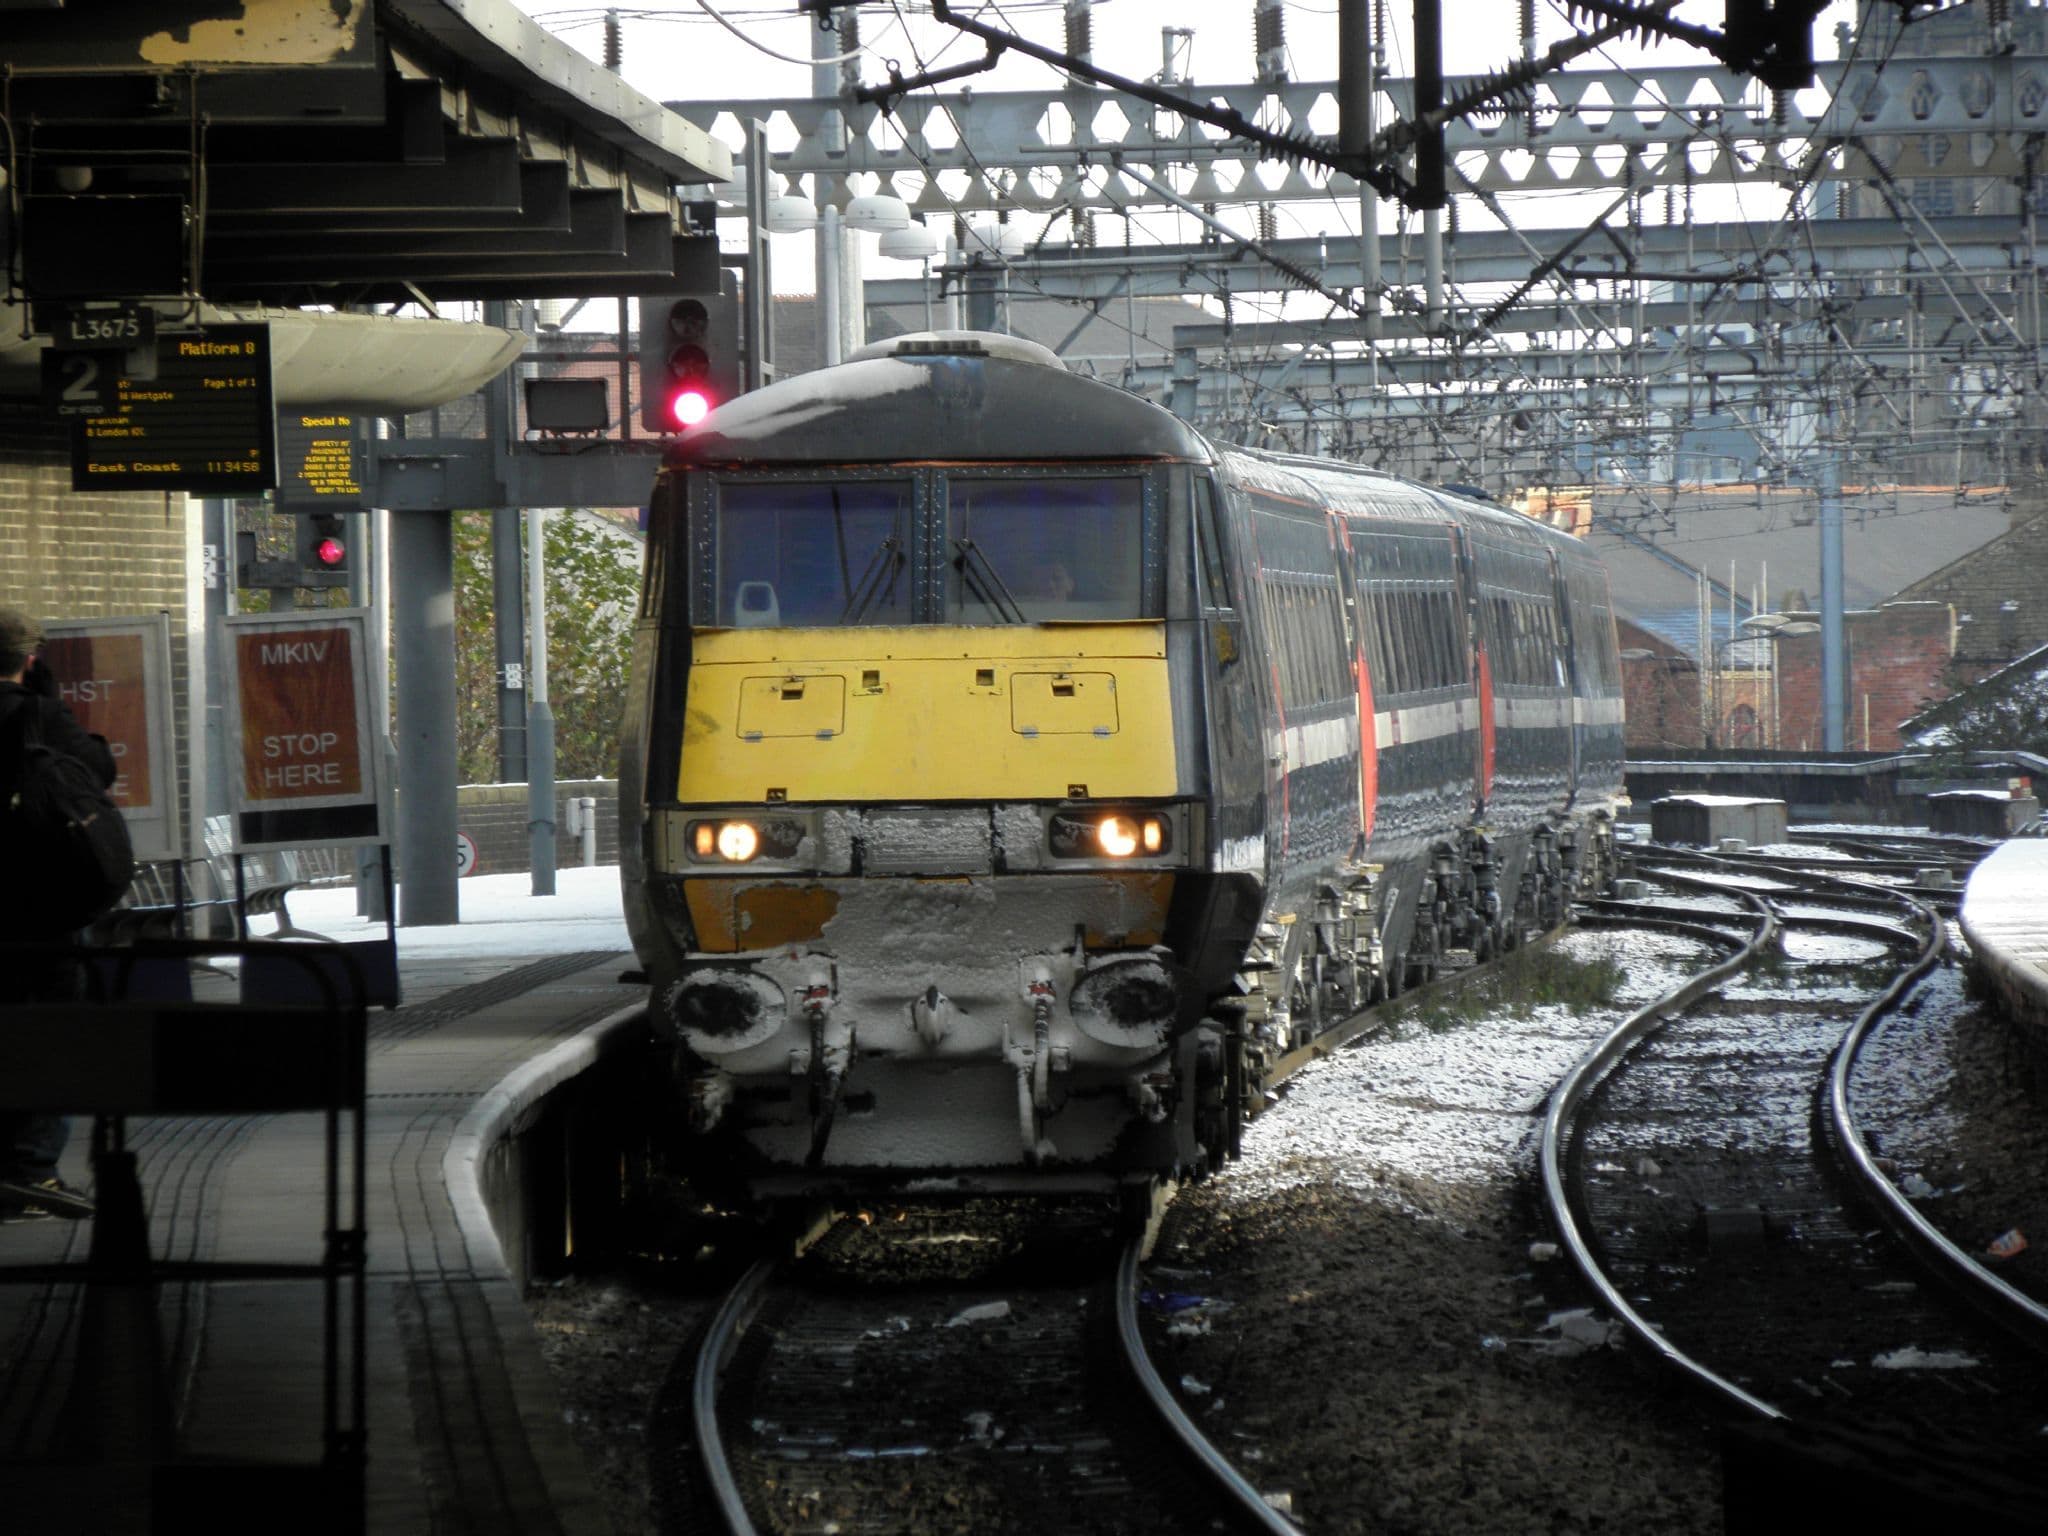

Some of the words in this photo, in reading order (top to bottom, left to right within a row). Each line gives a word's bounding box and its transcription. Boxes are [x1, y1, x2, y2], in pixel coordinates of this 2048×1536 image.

[71, 319, 139, 339] L3675
[180, 342, 240, 355] Platform
[61, 356, 99, 401] 2
[203, 378, 225, 389] Page
[228, 378, 234, 387] 1
[237, 378, 247, 387] of
[250, 378, 256, 387] 1
[302, 417, 335, 428] Special
[88, 463, 127, 473] East
[133, 462, 182, 472] Coast
[261, 641, 328, 664] MKIV
[58, 680, 114, 702] HST
[264, 732, 337, 757] STOP
[264, 763, 342, 789] HERE
